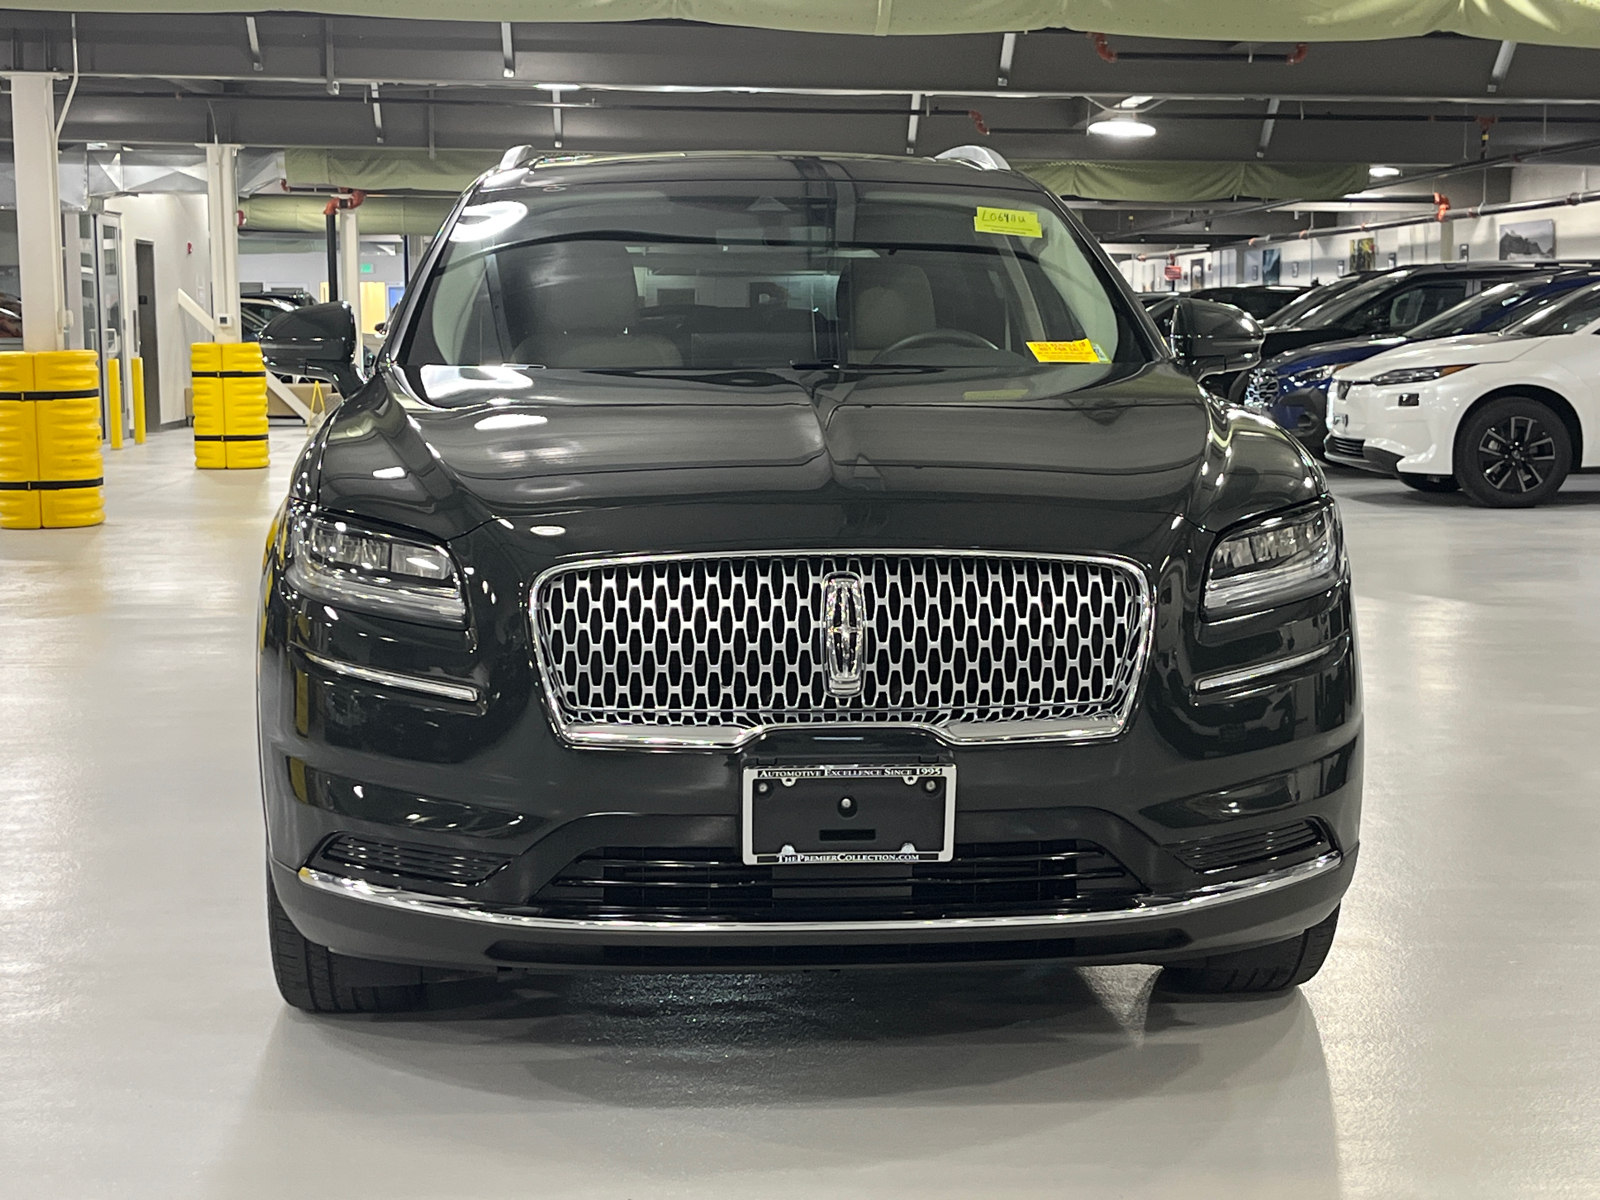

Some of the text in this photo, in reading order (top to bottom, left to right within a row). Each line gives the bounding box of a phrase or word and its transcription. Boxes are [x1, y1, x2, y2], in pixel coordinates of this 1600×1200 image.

[760, 769, 821, 777] AUTOMOTIVE
[884, 767, 912, 776] SINCE
[916, 767, 941, 775] 1995
